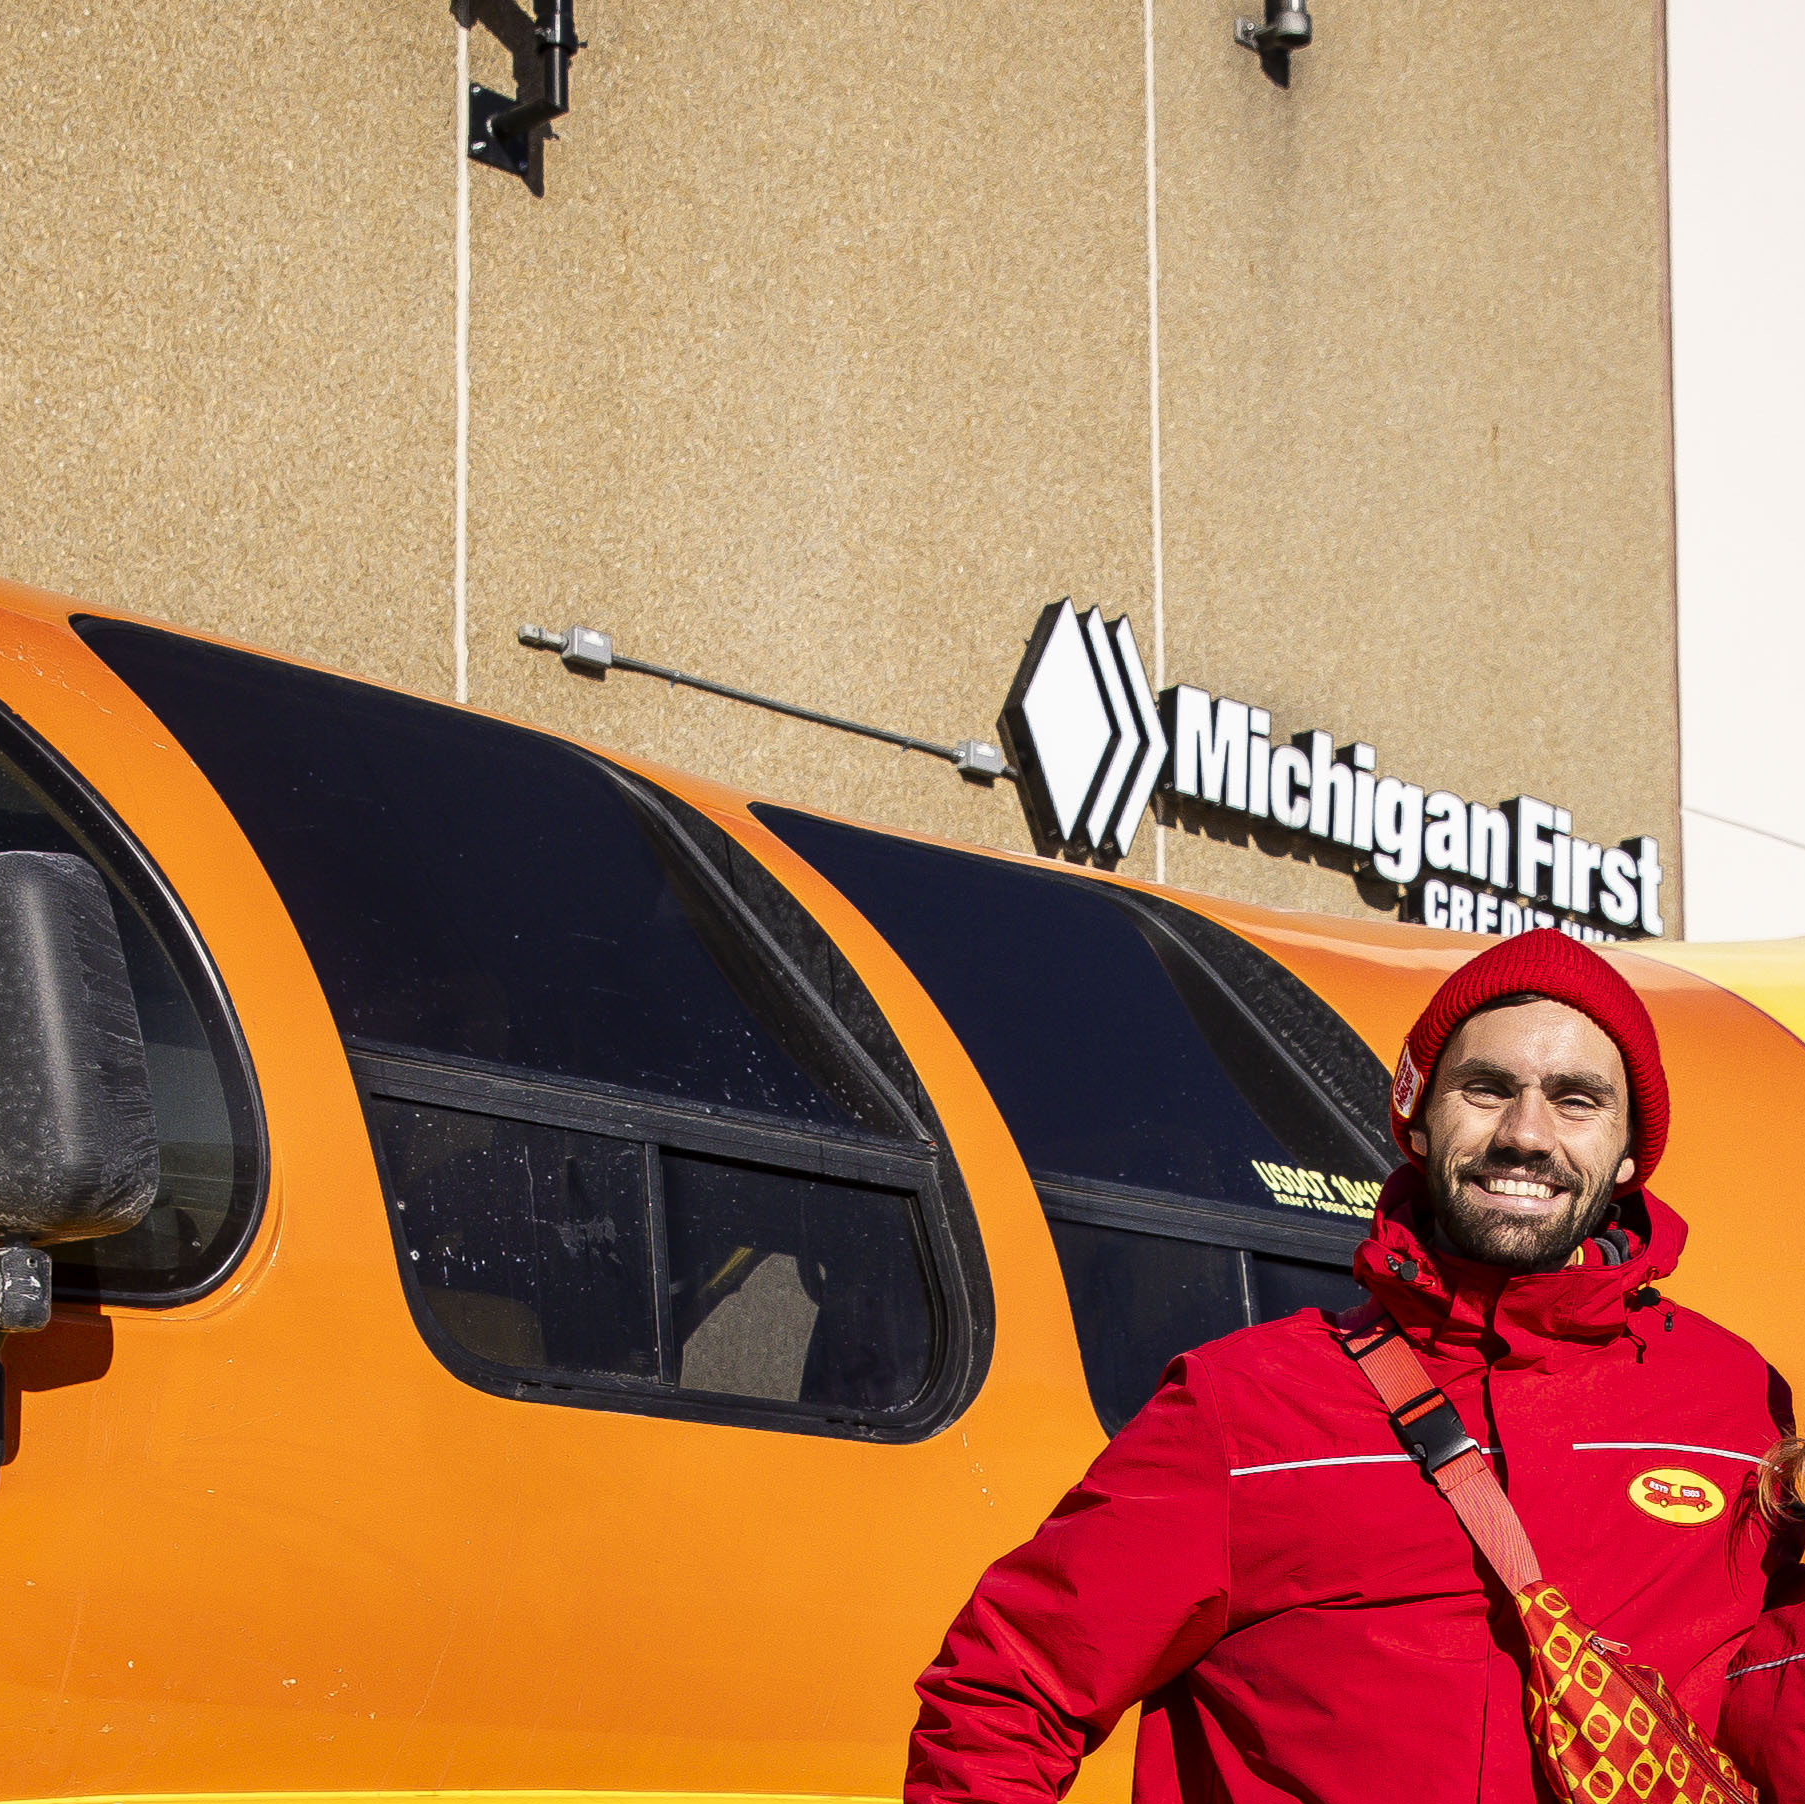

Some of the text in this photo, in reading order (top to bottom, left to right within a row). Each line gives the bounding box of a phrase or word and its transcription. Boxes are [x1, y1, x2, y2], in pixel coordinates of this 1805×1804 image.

[1174, 684, 1664, 937] Michigan First
[1251, 1159, 1336, 1201] USDOT
